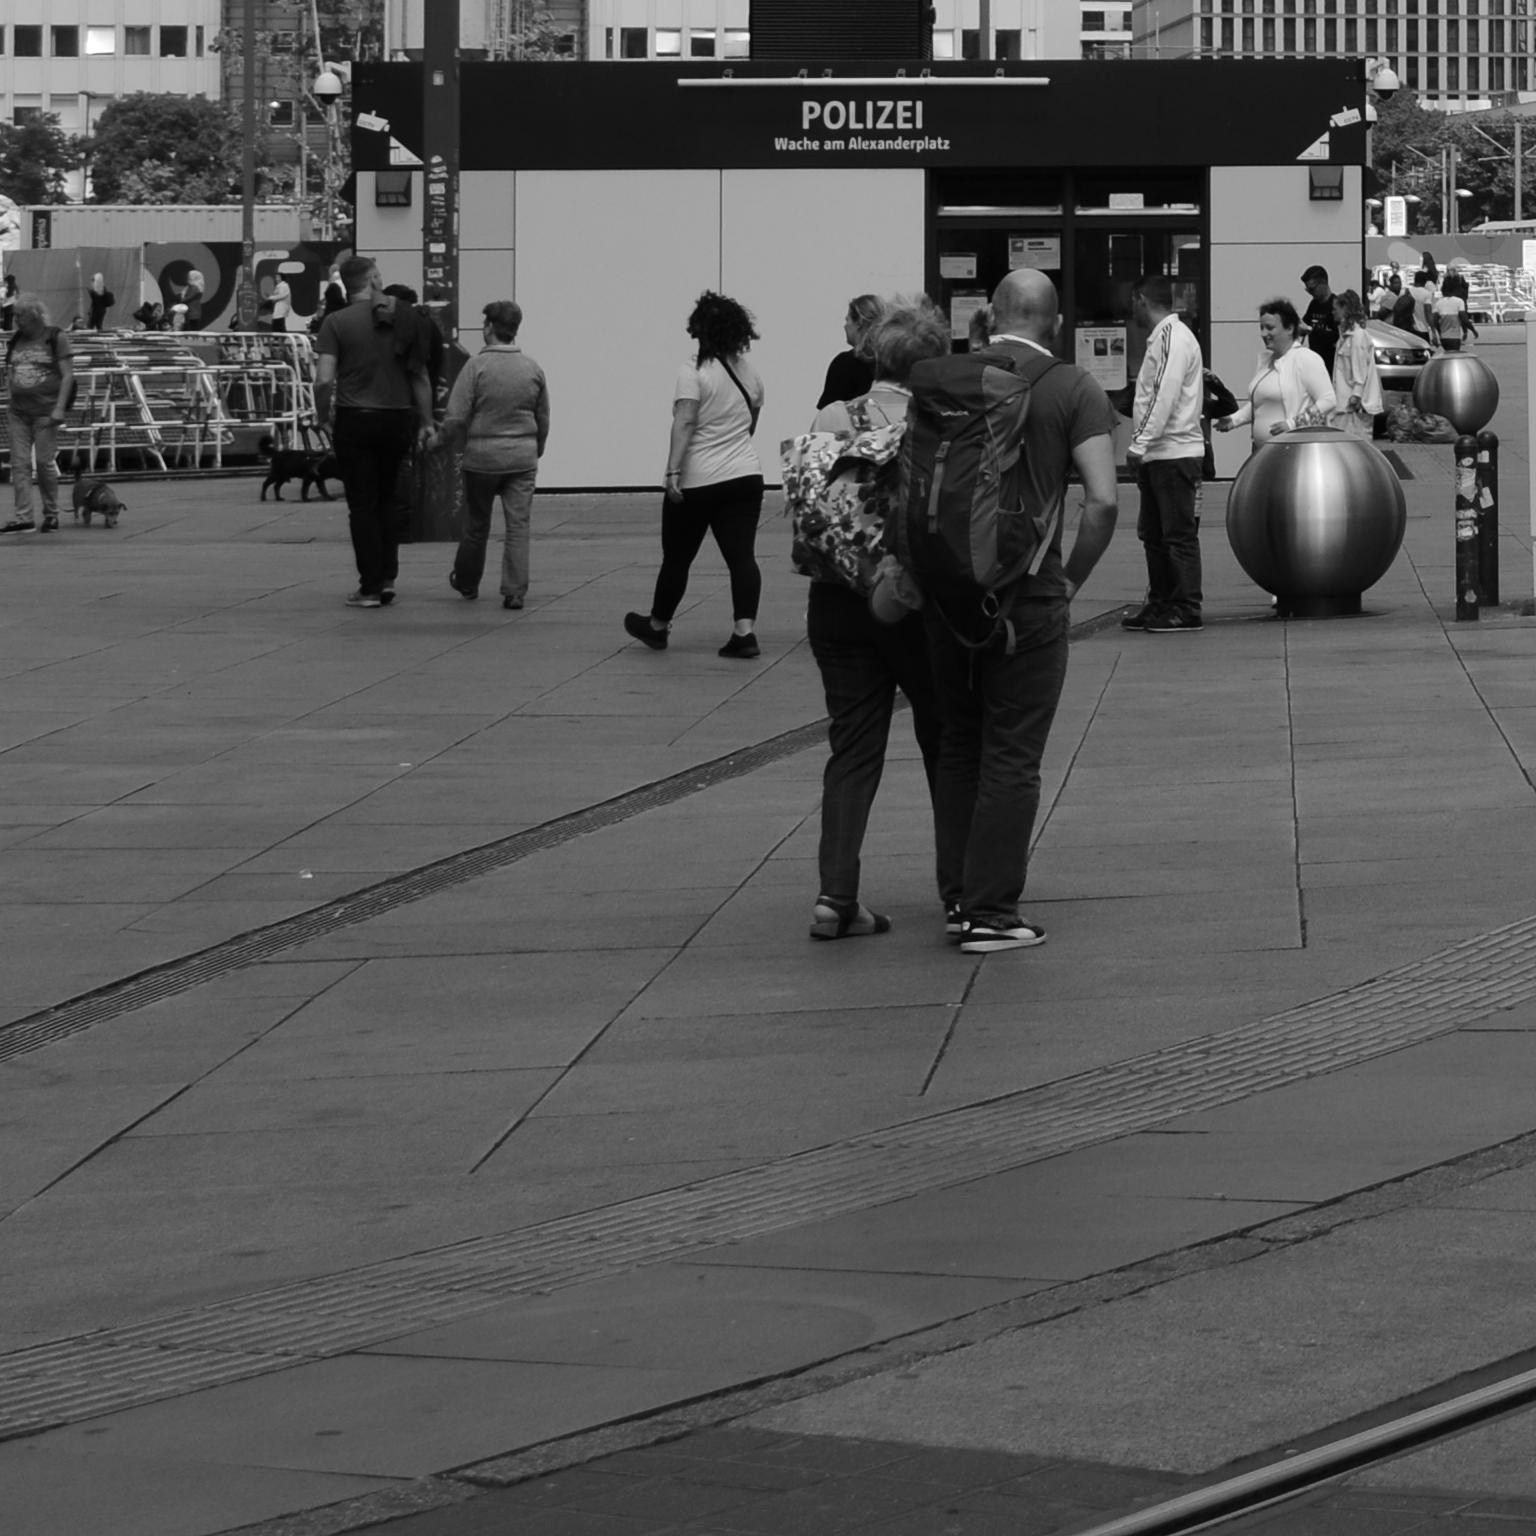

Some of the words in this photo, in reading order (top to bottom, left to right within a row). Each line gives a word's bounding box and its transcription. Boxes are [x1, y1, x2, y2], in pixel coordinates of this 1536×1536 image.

[802, 100, 923, 130] POLIZEI
[774, 137, 820, 151] Wache
[823, 140, 845, 151] am
[848, 136, 951, 153] Alexanderplatz
